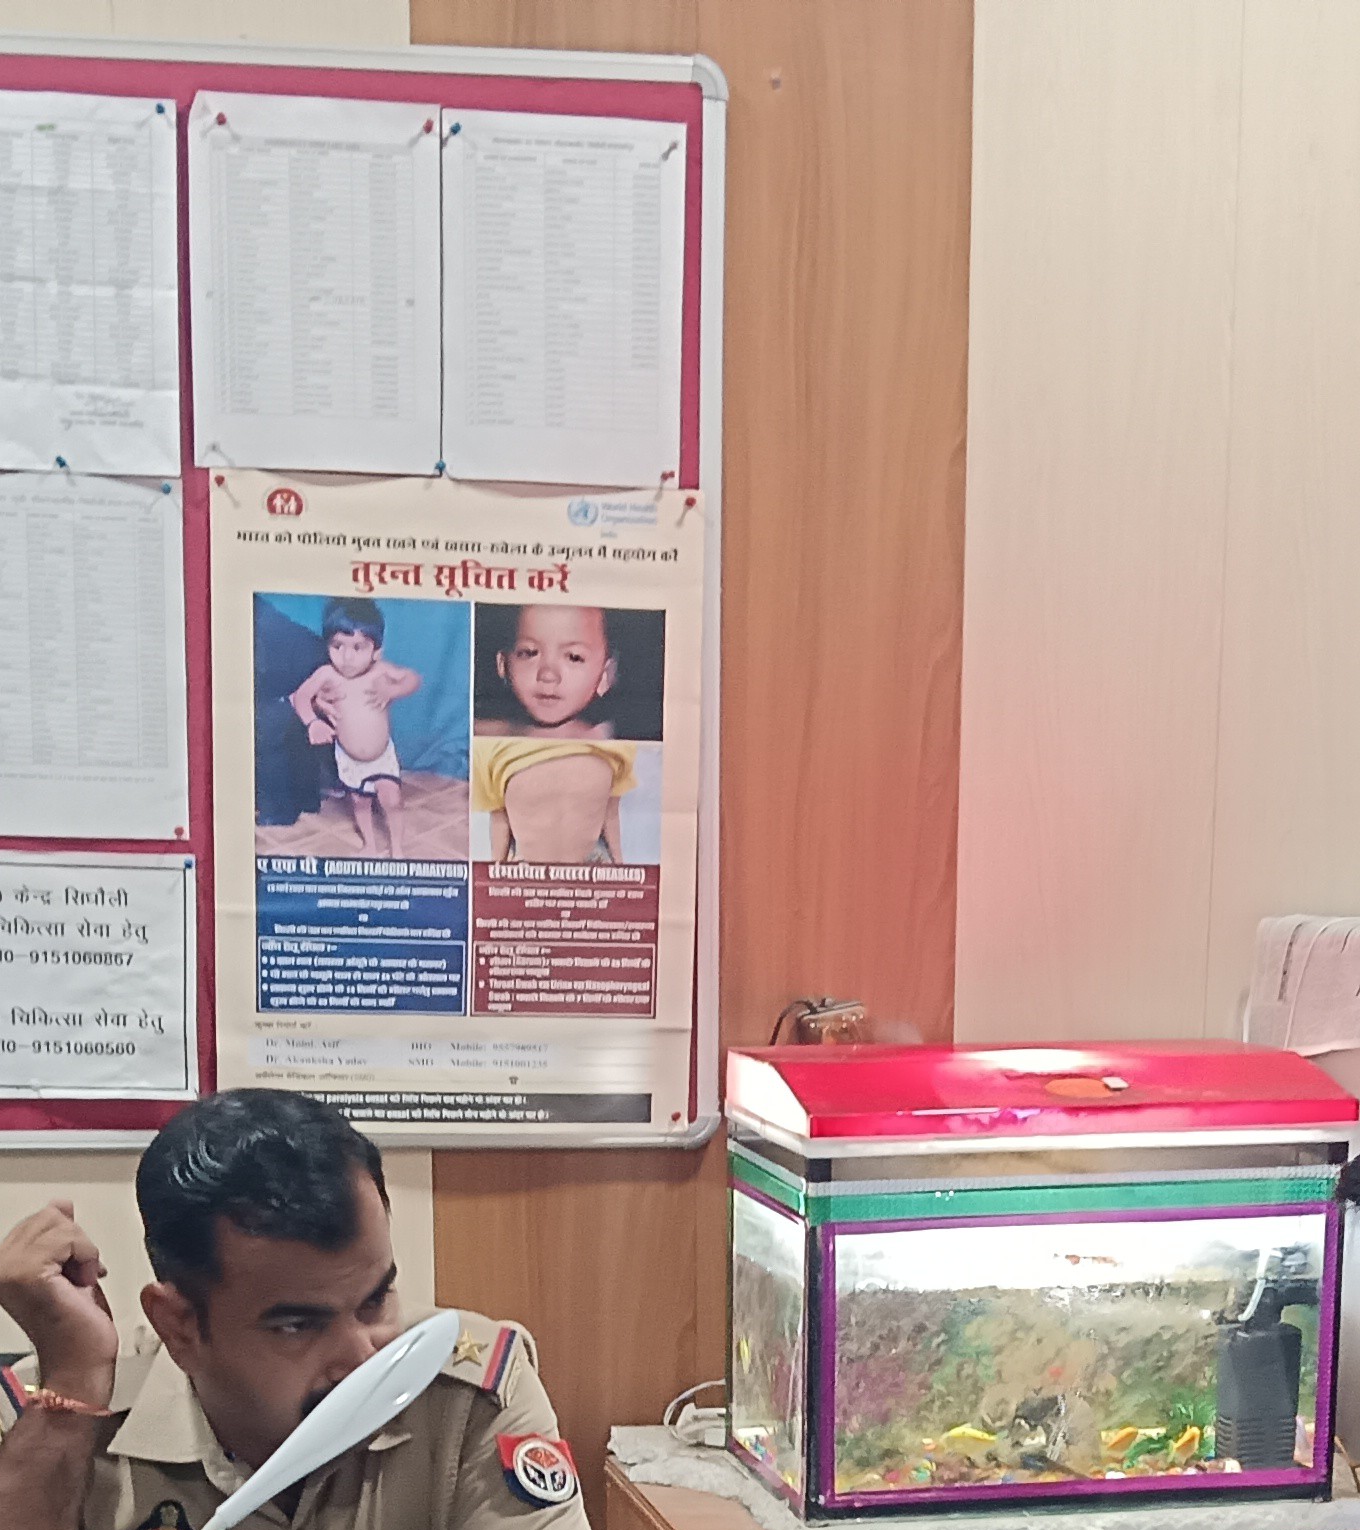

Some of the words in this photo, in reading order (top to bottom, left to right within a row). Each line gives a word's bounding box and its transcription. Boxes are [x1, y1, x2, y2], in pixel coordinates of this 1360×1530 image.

[350, 560, 425, 593] तुरन्त
[433, 559, 518, 598] सूचित
[527, 563, 570, 593] करें
